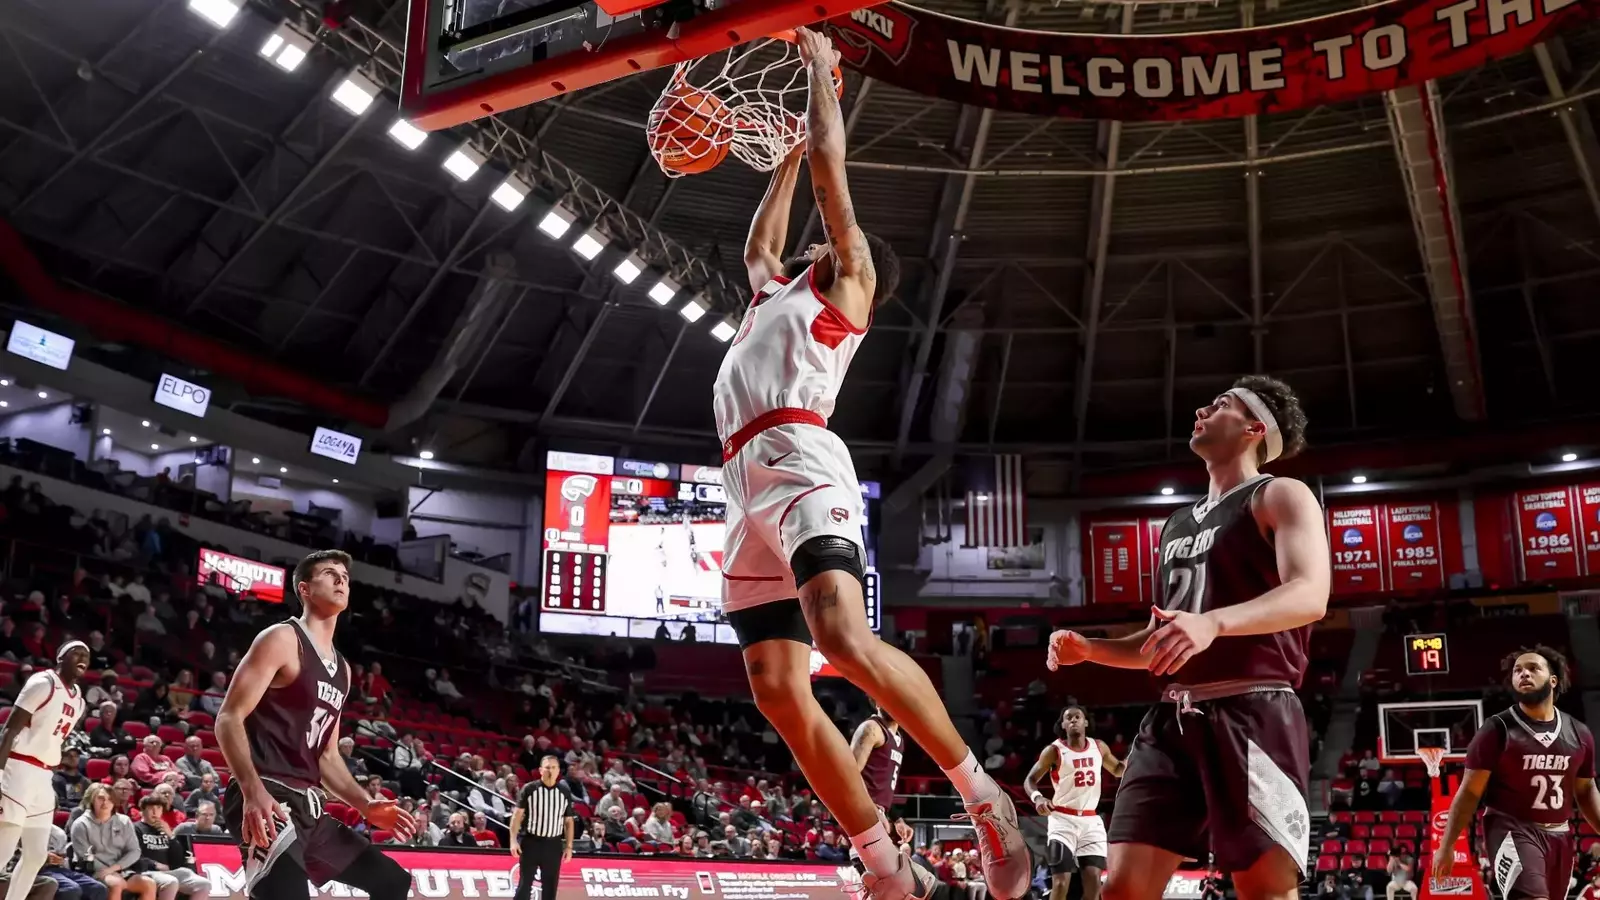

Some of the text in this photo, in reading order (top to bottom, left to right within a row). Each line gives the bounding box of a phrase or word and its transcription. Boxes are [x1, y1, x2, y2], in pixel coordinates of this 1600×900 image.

[851, 8, 894, 39] WKU
[947, 0, 1575, 98] WELCOME TO TH
[161, 377, 206, 404] ELPO
[319, 434, 348, 450] LOGAN
[1334, 508, 1371, 518] HILLTOPPER
[1392, 514, 1431, 523] BASKETBALL
[1333, 517, 1373, 527] BASKETBALL
[1528, 534, 1570, 548] 1986
[1335, 550, 1371, 563] 1971
[1396, 546, 1434, 559] 1985
[1169, 562, 1206, 614] 21
[1413, 638, 1442, 650] 19:48
[1423, 650, 1440, 669] 19
[1072, 757, 1094, 769] WKU
[1522, 755, 1571, 770] TIGERS
[1074, 770, 1096, 788] 23
[1530, 774, 1565, 810] 23
[581, 868, 635, 883] FREE
[585, 884, 689, 899] Medium Fry
